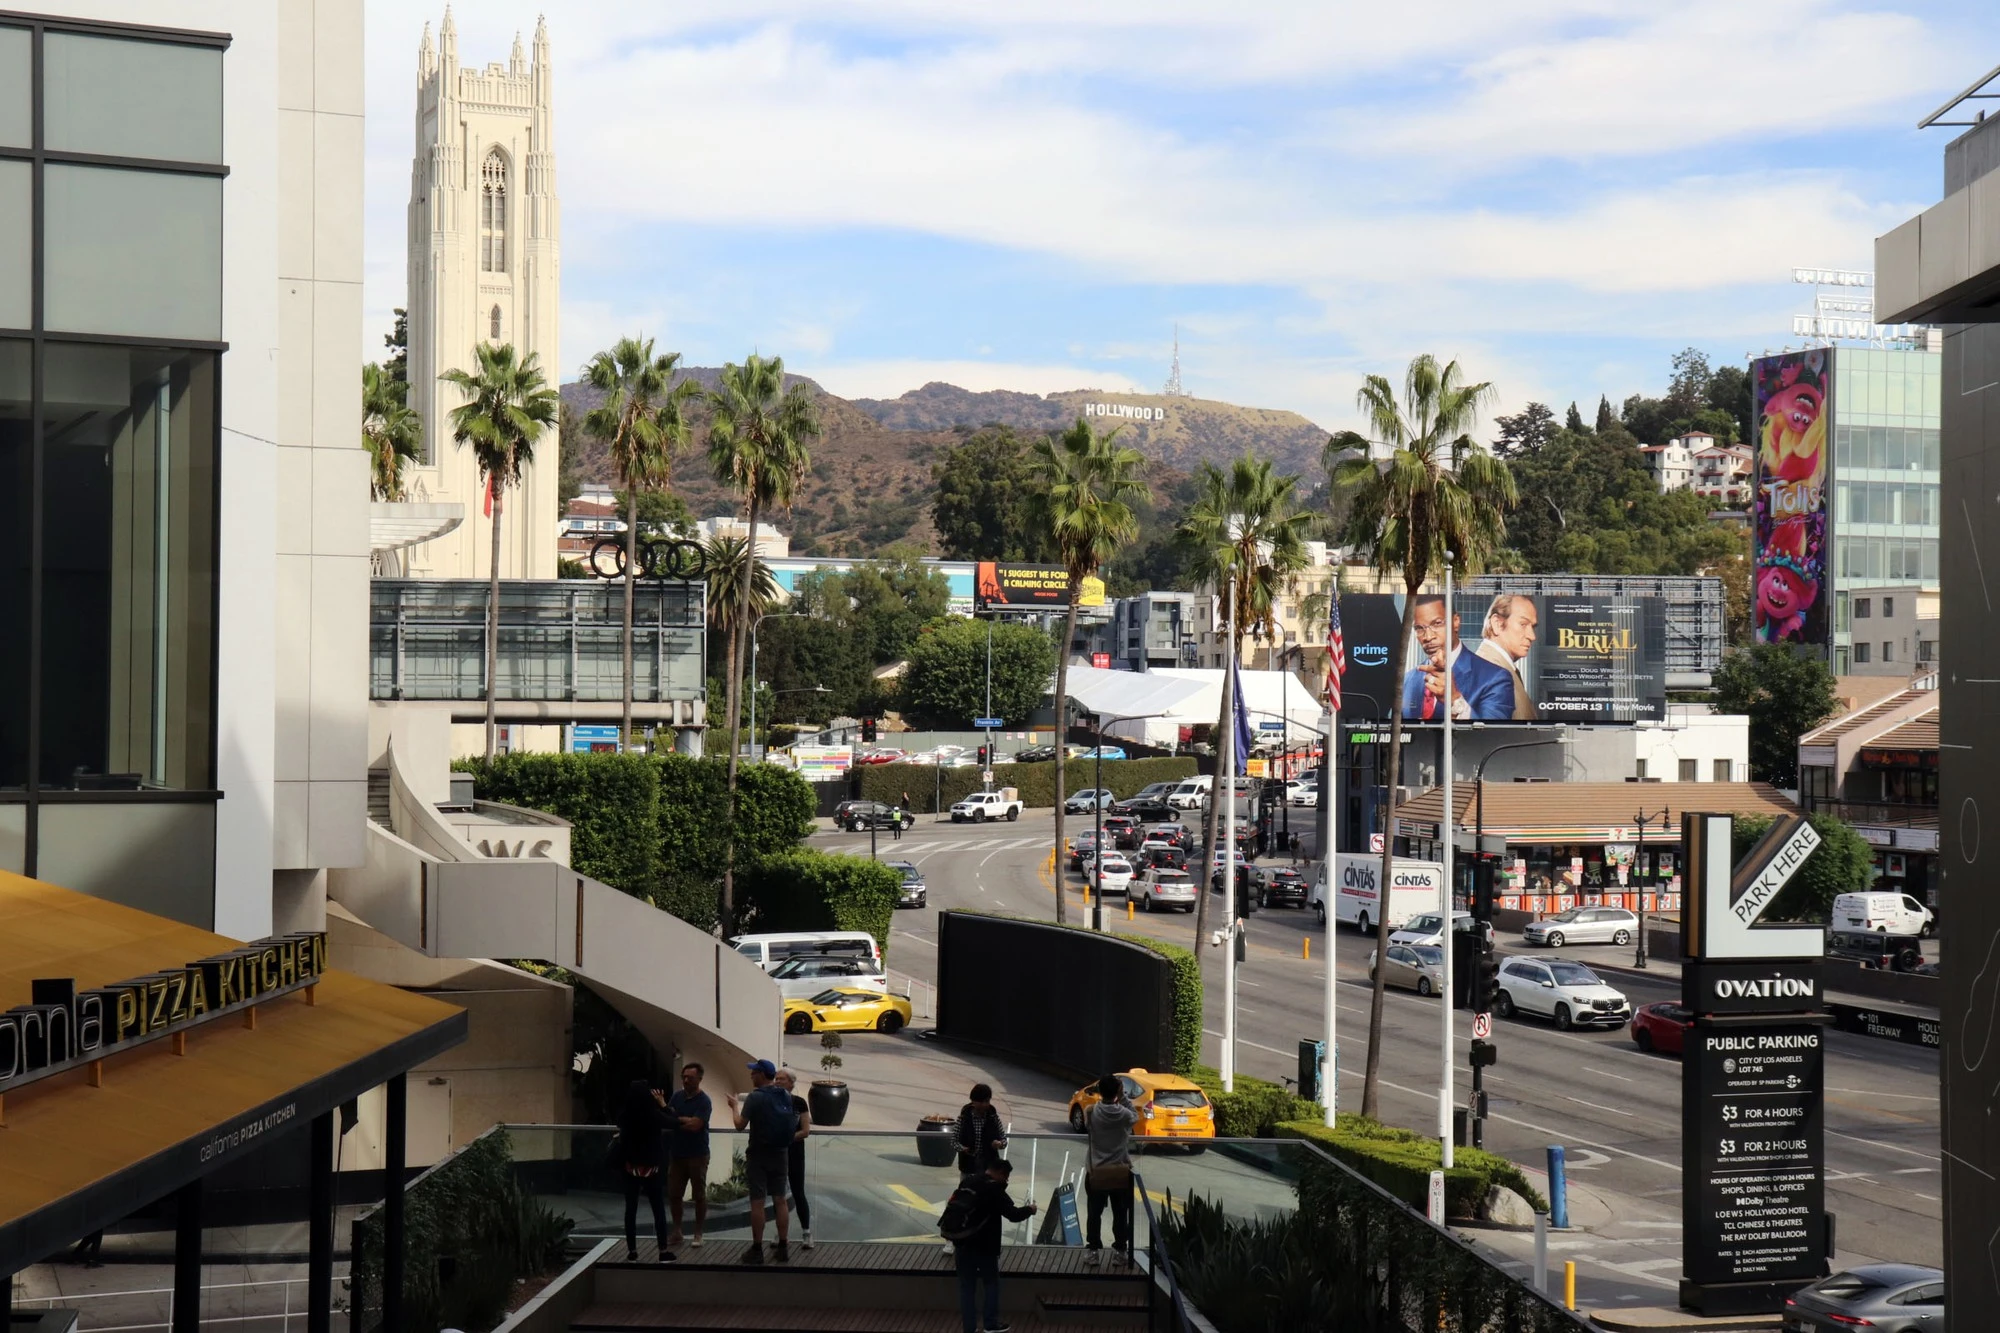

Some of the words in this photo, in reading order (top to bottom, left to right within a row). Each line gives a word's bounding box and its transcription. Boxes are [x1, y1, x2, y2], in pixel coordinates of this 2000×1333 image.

[1086, 403, 1164, 420] HOLLYWOOD
[1761, 480, 1820, 518] Trolls
[1011, 580, 1041, 588] CALMING
[1558, 628, 1637, 653] BURIAL
[1353, 644, 1389, 657] prime
[1344, 861, 1375, 890] CINTAS
[1394, 873, 1431, 886] CINTAS
[1735, 873, 1777, 923] PARK
[1773, 827, 1816, 877] HERE
[116, 967, 208, 1042] PIZZA
[219, 933, 329, 1009] KITCHEN
[1715, 972, 1814, 998] OVATION
[1868, 1014, 1879, 1023] 101
[1868, 1024, 1901, 1038] FREEWAY
[1918, 1022, 1940, 1034] HOLL
[1707, 1037, 1755, 1050] PUBLIC
[1759, 1035, 1818, 1048] PARKING
[1722, 1105, 1738, 1121] $3
[1745, 1109, 1762, 1118] FOR
[1764, 1109, 1770, 1117] 4
[1772, 1108, 1803, 1117] HOURS
[200, 1132, 239, 1162] california
[241, 1119, 263, 1142] PIZZA
[265, 1102, 296, 1130] KITCHEN
[1720, 1139, 1735, 1155] $3
[1744, 1142, 1763, 1151] FOR
[1765, 1141, 1770, 1151] 2
[1773, 1140, 1807, 1150] HOURS
[1747, 1185, 1772, 1193] DINING,
[1745, 1198, 1764, 1206] Dolby
[1715, 1210, 1743, 1218] LOEWS
[1745, 1208, 1787, 1216] HOLLYWOOD
[1772, 1219, 1803, 1227] THEATRES
[1771, 1231, 1806, 1239] BALLROOM
